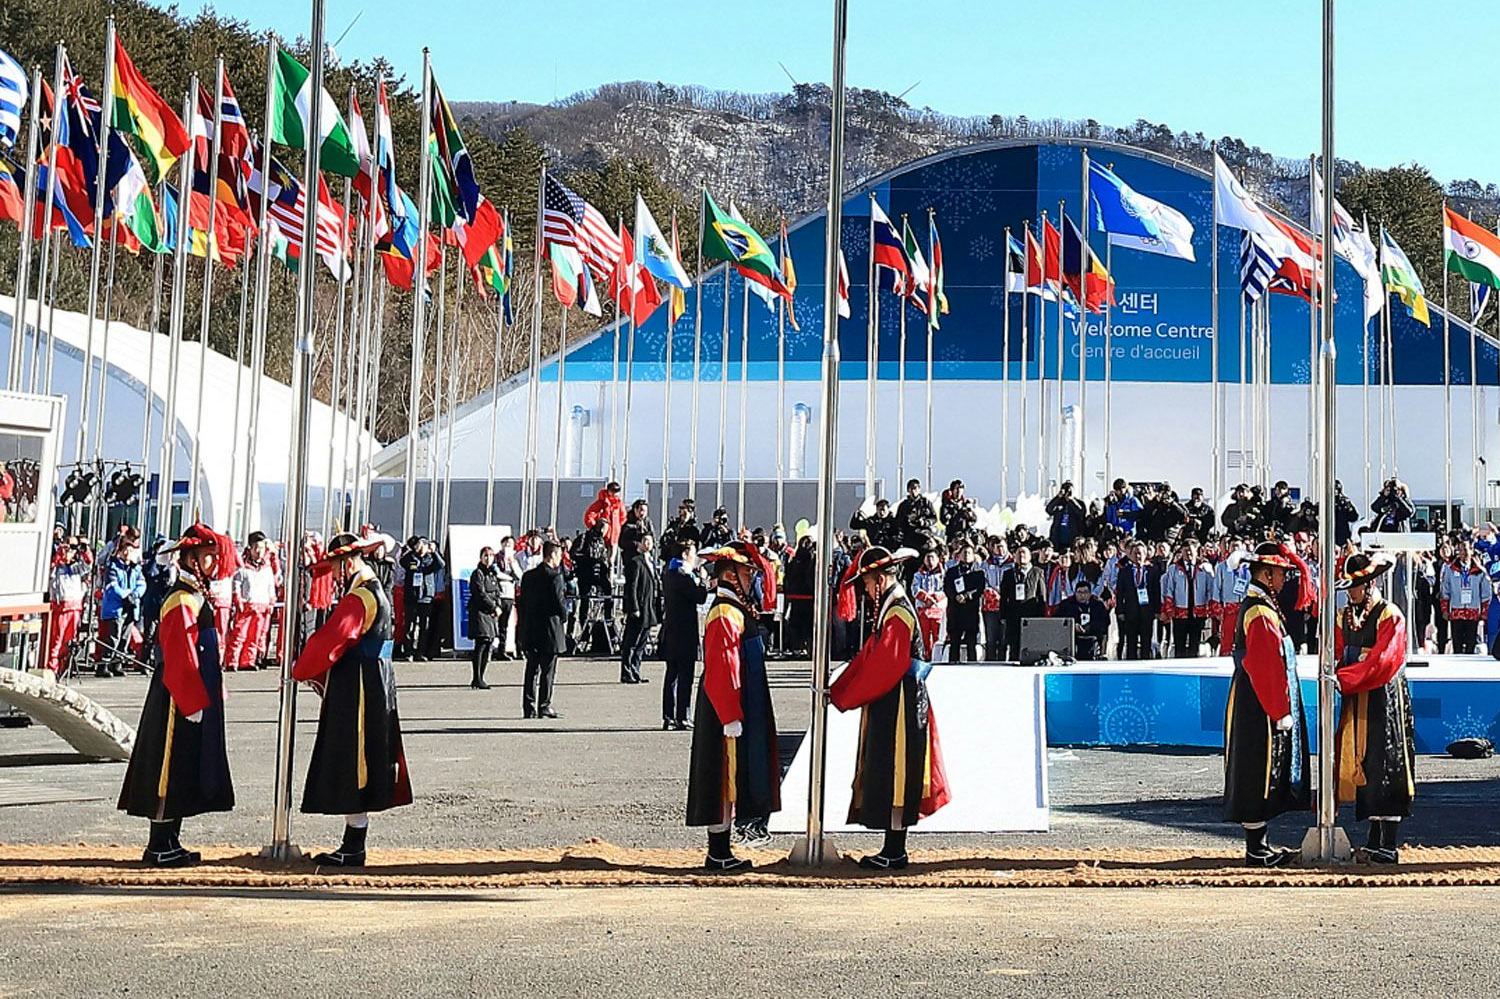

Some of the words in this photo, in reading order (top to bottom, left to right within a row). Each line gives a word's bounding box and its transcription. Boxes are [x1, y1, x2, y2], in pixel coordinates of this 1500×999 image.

[1118, 292, 1159, 315] 센터
[1071, 321, 1152, 338] Welcome
[1155, 322, 1215, 339] Centre
[1071, 342, 1126, 359] Cenre
[1130, 343, 1201, 360] d'accueil
